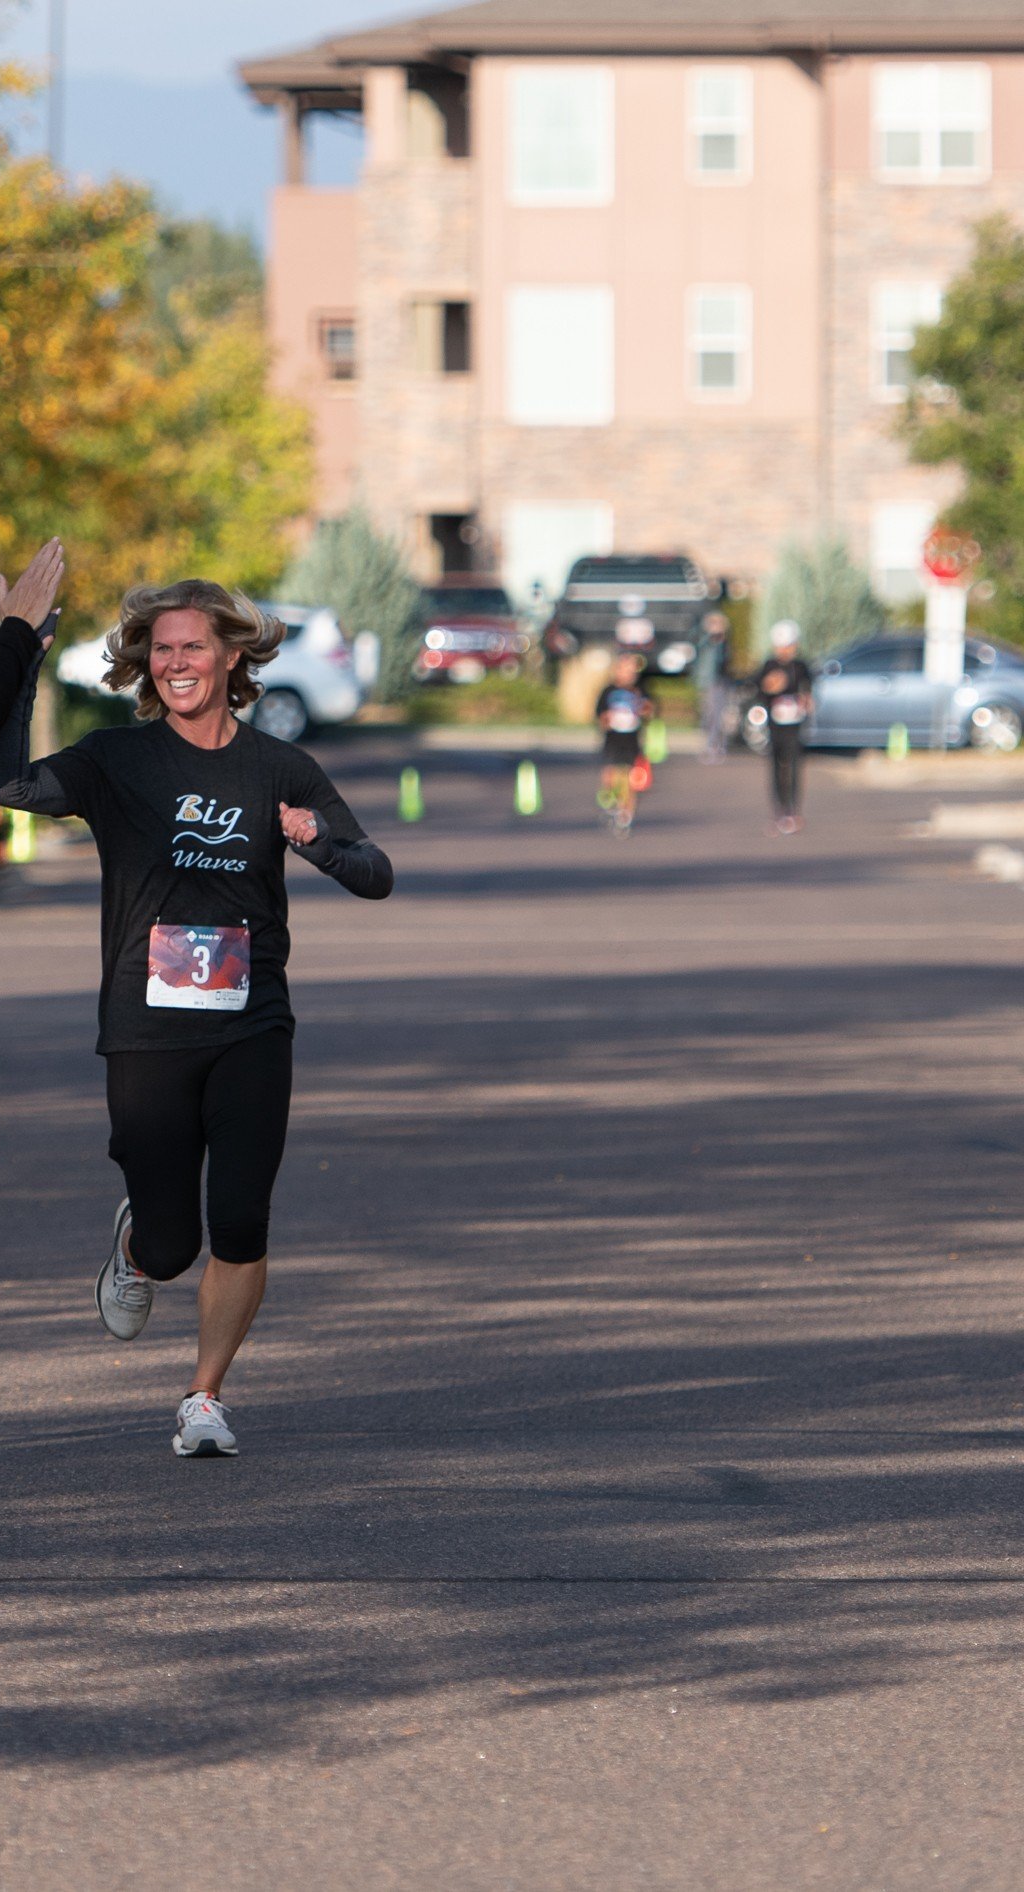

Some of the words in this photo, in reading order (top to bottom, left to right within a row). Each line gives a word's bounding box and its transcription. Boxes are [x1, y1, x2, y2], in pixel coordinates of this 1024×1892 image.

[175, 794, 243, 840] Big
[172, 849, 247, 873] Waves
[191, 945, 211, 984] 3
